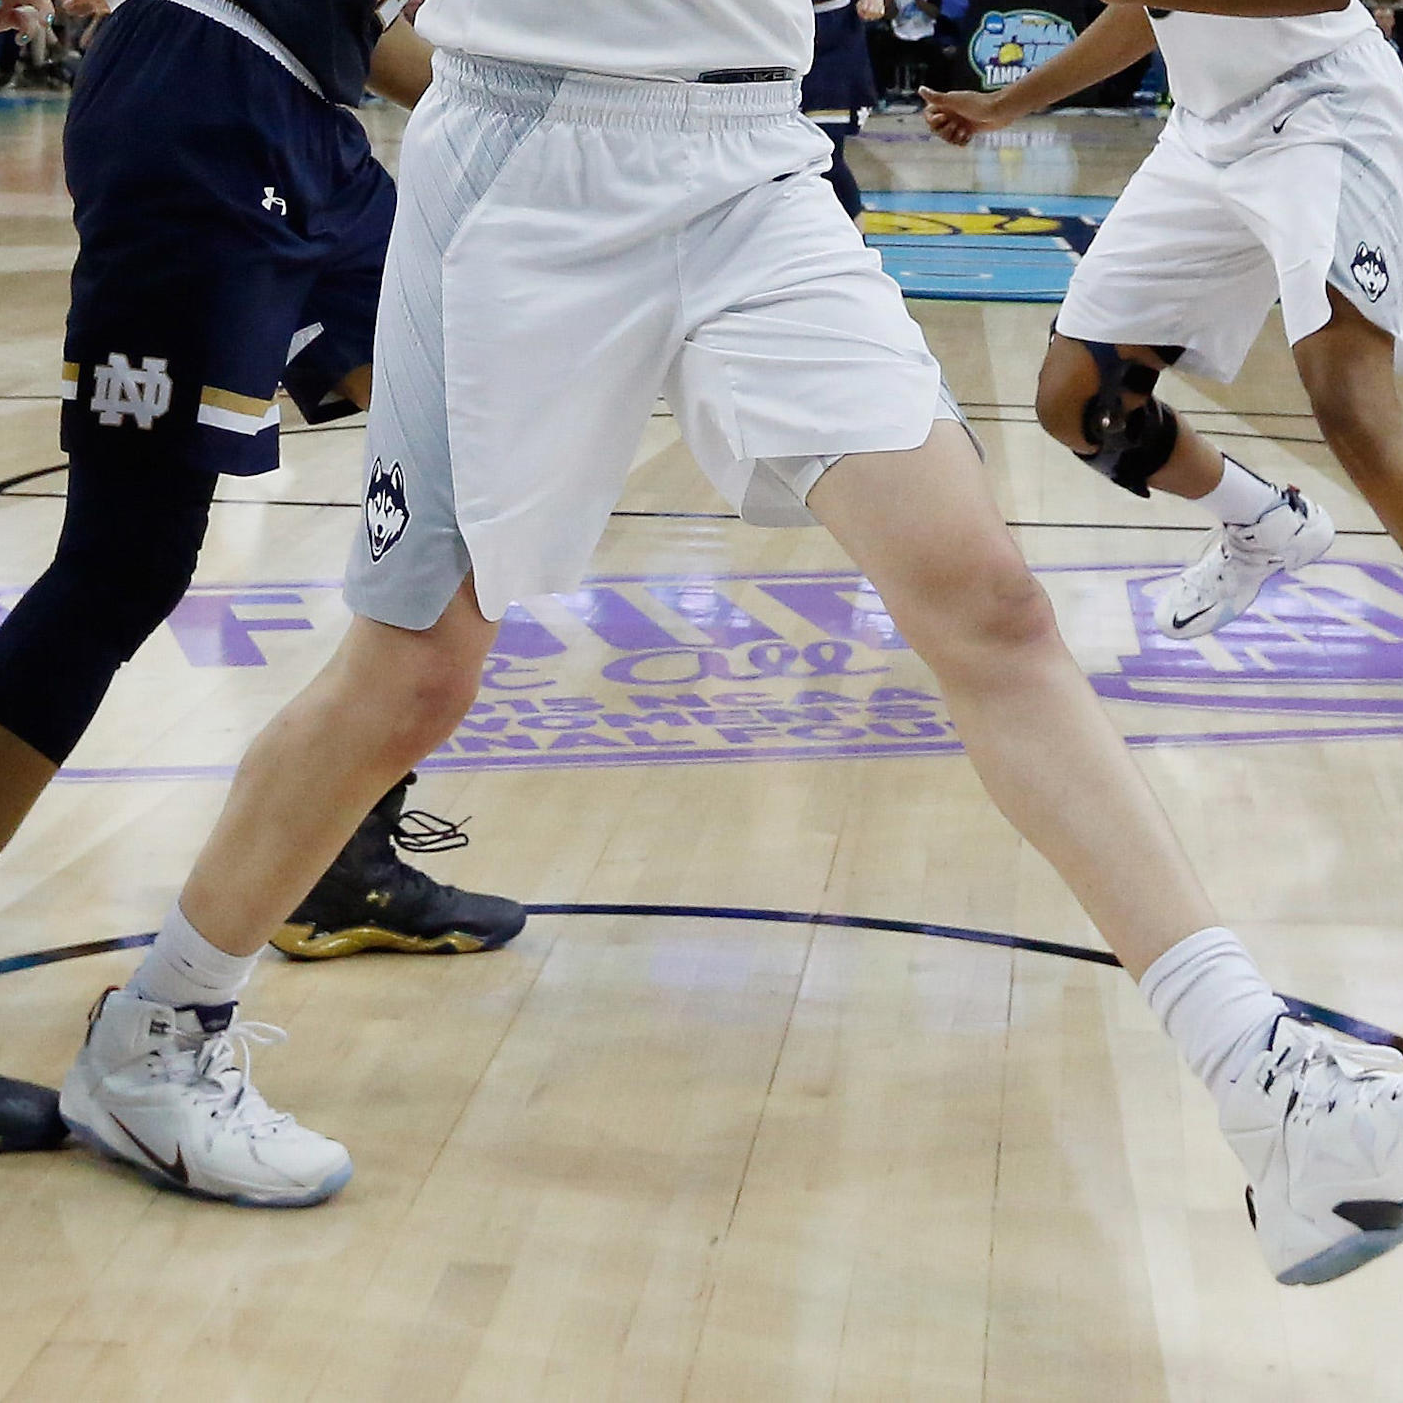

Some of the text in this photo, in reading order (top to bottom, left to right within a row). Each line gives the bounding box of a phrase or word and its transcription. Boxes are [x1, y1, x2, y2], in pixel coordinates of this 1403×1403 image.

[627, 687, 941, 710] NCAA
[436, 721, 955, 753] INAL FOU
